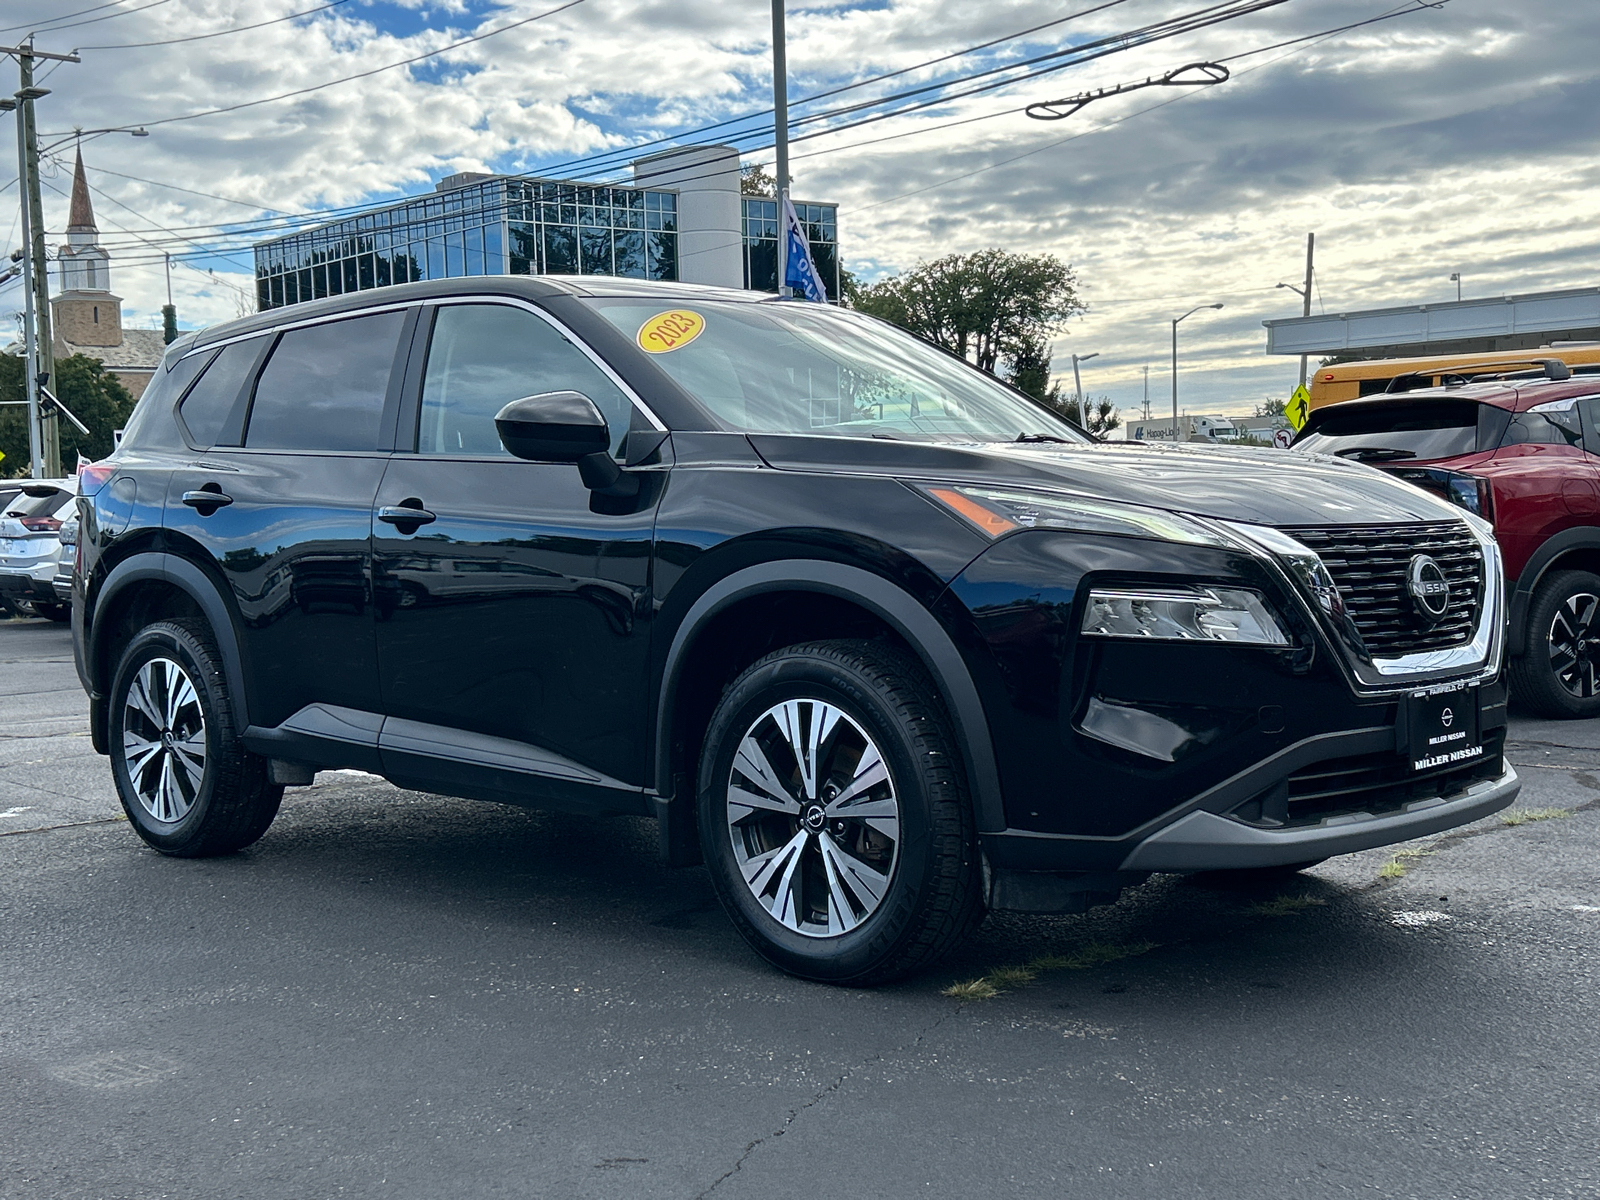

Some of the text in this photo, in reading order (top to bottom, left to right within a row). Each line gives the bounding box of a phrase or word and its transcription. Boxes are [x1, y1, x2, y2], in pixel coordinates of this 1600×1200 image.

[648, 313, 695, 347] 2023
[1147, 426, 1180, 439] Hapag-Llod
[1413, 582, 1449, 594] NISSAN
[1429, 731, 1466, 745] MILLER NISSAN
[1415, 746, 1483, 770] MILLER NISSAN
